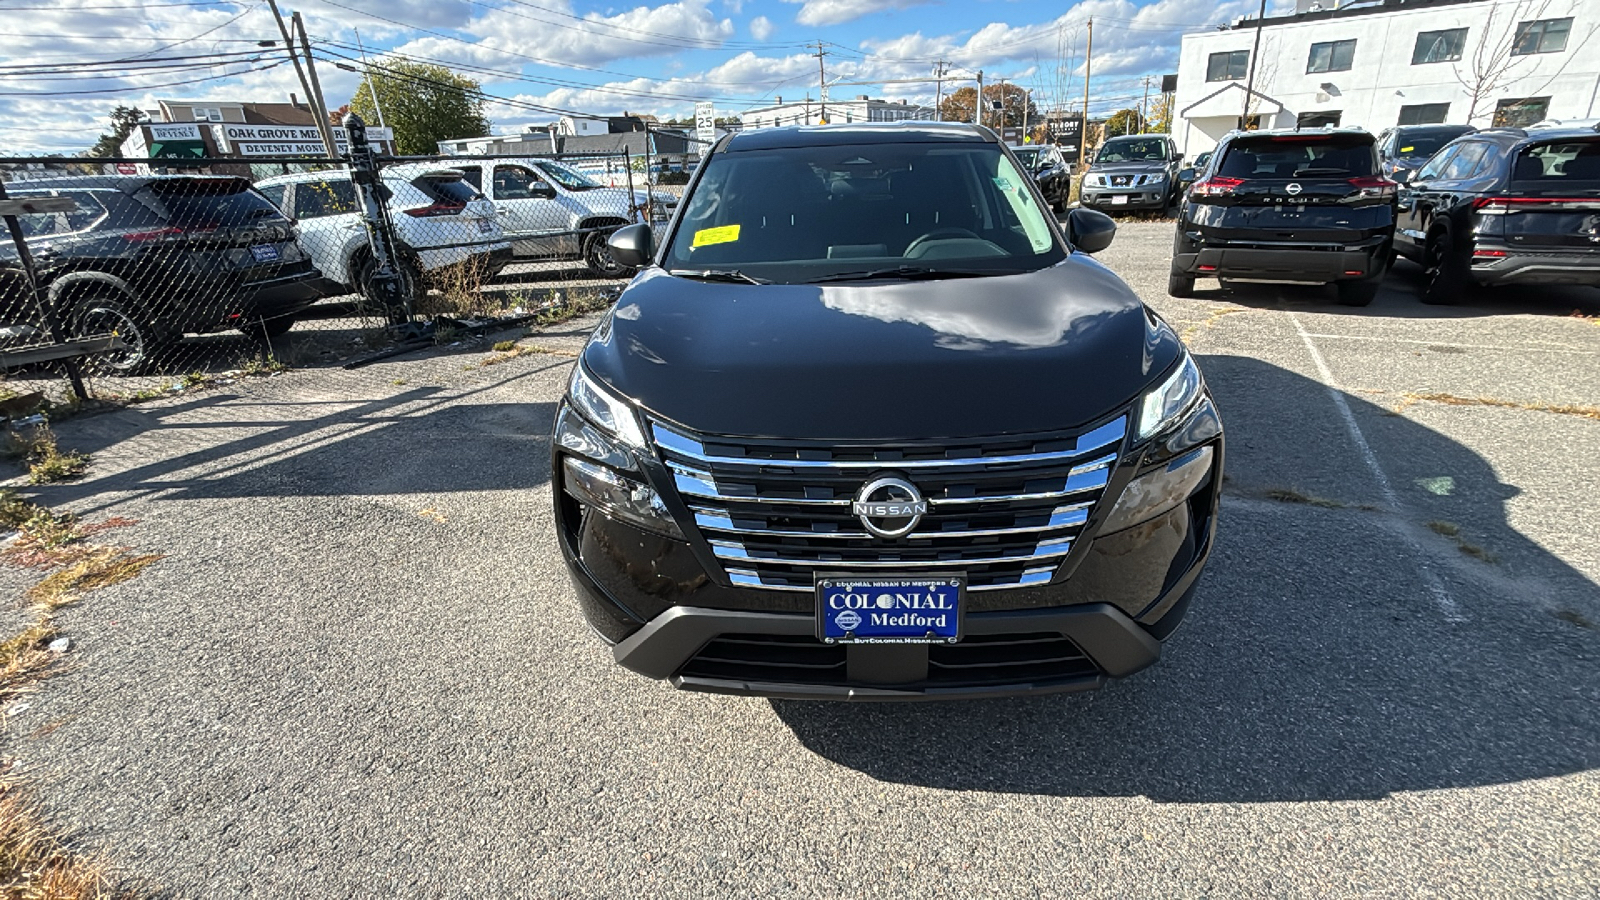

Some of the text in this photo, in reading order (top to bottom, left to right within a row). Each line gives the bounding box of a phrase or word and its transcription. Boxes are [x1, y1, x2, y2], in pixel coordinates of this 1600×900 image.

[698, 117, 713, 128] 25
[228, 128, 257, 138] OAK
[258, 129, 298, 139] GROVE
[855, 503, 926, 515] NISSAN
[829, 593, 953, 610] COLONIAL
[870, 612, 947, 627] Medford
